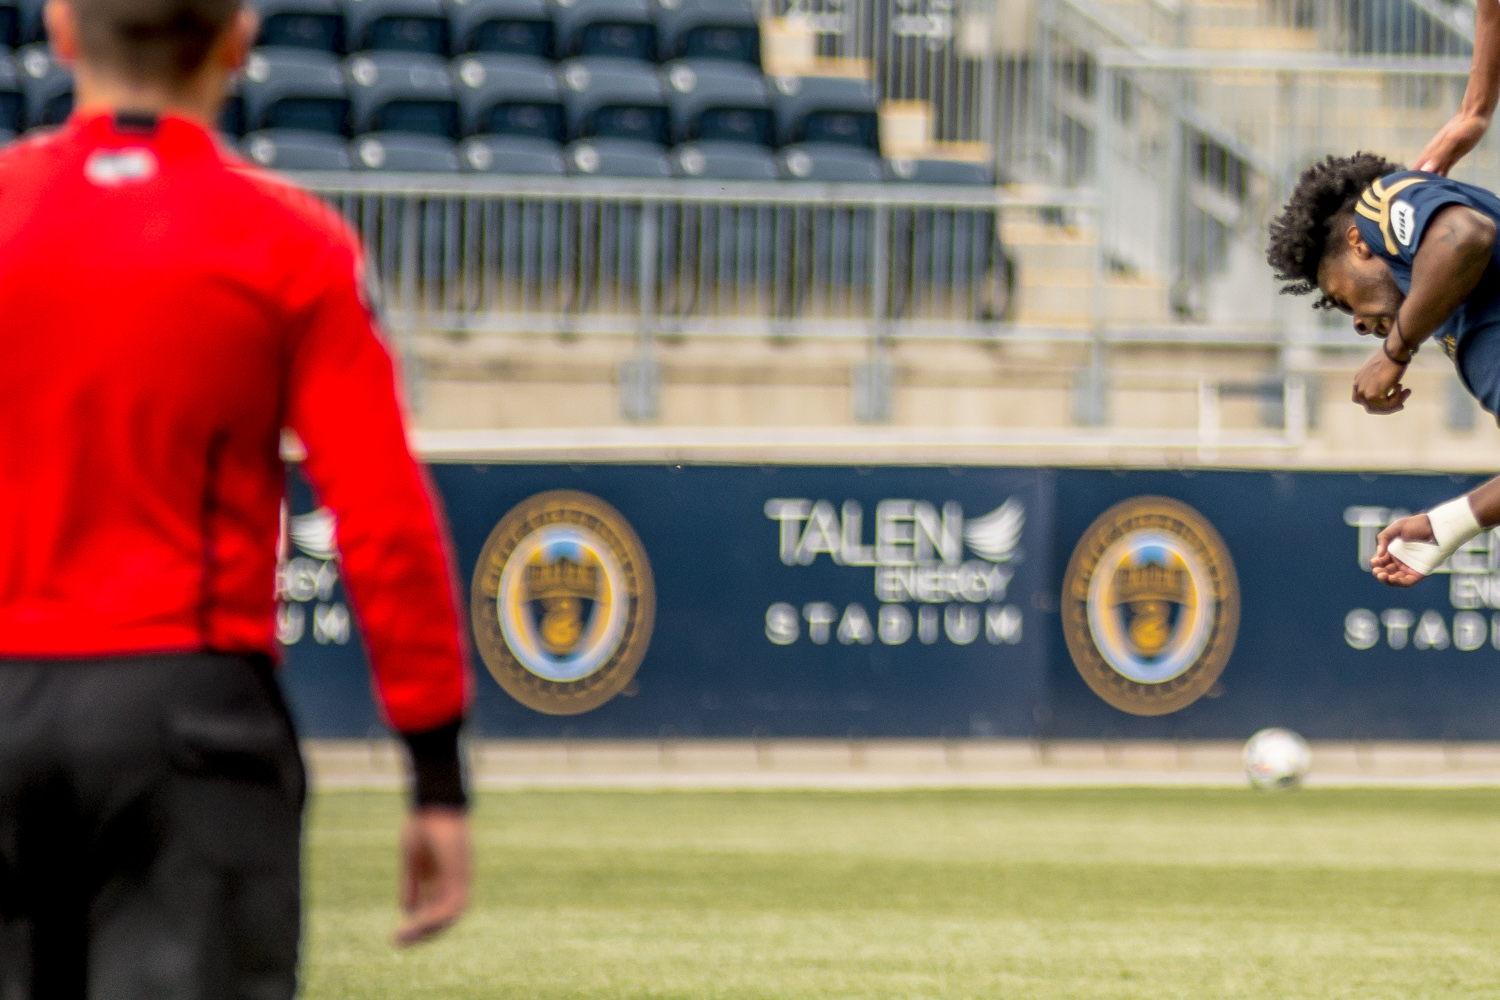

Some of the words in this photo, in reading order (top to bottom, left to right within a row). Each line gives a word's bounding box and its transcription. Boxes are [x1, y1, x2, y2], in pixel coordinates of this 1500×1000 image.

[764, 498, 964, 567] TALEN
[875, 560, 1014, 602] ENERGY
[764, 602, 1023, 645] STADIUM
